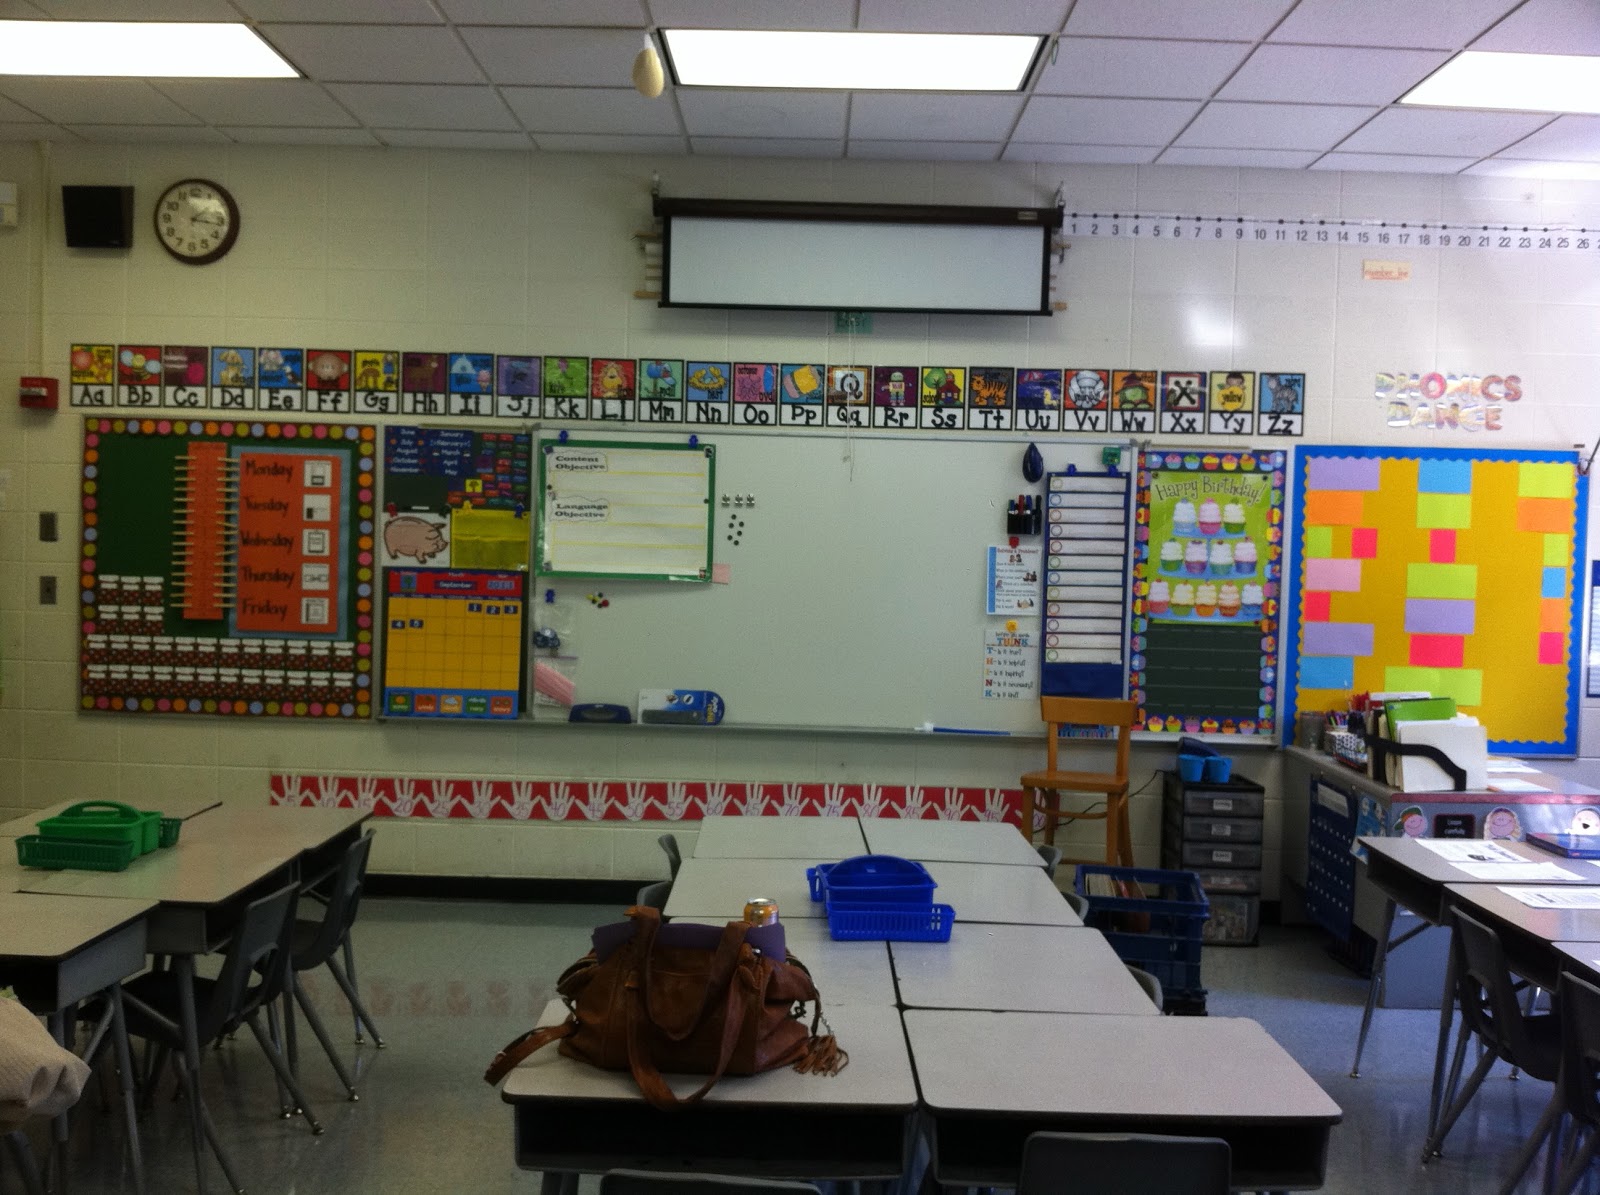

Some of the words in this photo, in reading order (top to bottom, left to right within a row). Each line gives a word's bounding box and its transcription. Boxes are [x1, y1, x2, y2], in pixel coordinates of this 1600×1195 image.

[167, 201, 179, 211] 10
[162, 213, 172, 223] 9
[216, 216, 225, 227] 3
[166, 226, 175, 237] 8
[211, 230, 219, 239] 4
[1091, 223, 1099, 236] 2
[1111, 223, 1120, 236] 3
[1132, 224, 1140, 236] 4
[1152, 224, 1161, 237] 5
[1173, 225, 1182, 238] 6
[1194, 226, 1202, 238] 7
[1214, 227, 1223, 239] 8
[1235, 227, 1244, 240] 9
[1255, 228, 1268, 241] 10
[1276, 229, 1286, 241] 11
[1297, 229, 1308, 242] 12
[1317, 230, 1329, 242] 13
[1338, 230, 1349, 243] 14
[1358, 231, 1370, 244] 15
[1378, 232, 1390, 244] 16
[1399, 233, 1411, 245] 17
[1419, 233, 1431, 246] 18
[1439, 234, 1452, 247] 19
[1459, 235, 1472, 248] 20
[1479, 235, 1490, 248] 21
[1499, 236, 1512, 249] 22
[1519, 236, 1532, 249] 23
[1539, 237, 1552, 250] 24
[1557, 236, 1570, 249] 25
[1577, 237, 1590, 250] 26
[176, 237, 184, 246] 7
[201, 239, 209, 249] 5
[841, 373, 862, 399] Q
[80, 384, 104, 405] Aa
[128, 385, 152, 405] Bb
[174, 385, 198, 406] Cc
[221, 387, 245, 407] Dd
[269, 389, 293, 409] Ee
[318, 391, 342, 411] Ff
[364, 390, 389, 412] Gg
[413, 392, 438, 413] Hh
[460, 393, 480, 414] Ii
[507, 396, 532, 417] Jj
[554, 397, 579, 418] Kk
[601, 400, 625, 419] Ll
[650, 401, 674, 420] Mm
[696, 402, 721, 422] Nn
[743, 404, 769, 424] Oo
[791, 405, 816, 425] Pp
[837, 406, 862, 426] Qq
[884, 407, 908, 427] Rr
[931, 407, 957, 428] Ss
[979, 410, 1004, 429] Tt
[1026, 410, 1050, 430] Uu
[1074, 410, 1099, 430] Vv
[1120, 411, 1145, 431] Ww
[1171, 413, 1196, 432] Xx
[1220, 413, 1245, 433] Yy
[1268, 413, 1293, 435] Zz
[246, 460, 293, 482] Monday
[555, 463, 605, 471] Objective
[1155, 480, 1200, 501] Happy
[1202, 475, 1267, 507] Birthday!
[245, 496, 289, 518] Tuesday
[556, 503, 608, 511] Language
[555, 511, 605, 519] Objective
[242, 567, 295, 589] Thursday
[439, 581, 473, 590] September
[242, 598, 287, 622] Friday
[997, 638, 1029, 646] THINK
[396, 798, 413, 812] 20
[668, 802, 683, 815] 55
[784, 804, 799, 816] 70
[826, 804, 842, 817] 75
[863, 804, 880, 817] 80
[905, 804, 920, 818] 85
[944, 805, 960, 820] 90
[984, 805, 999, 821] 95
